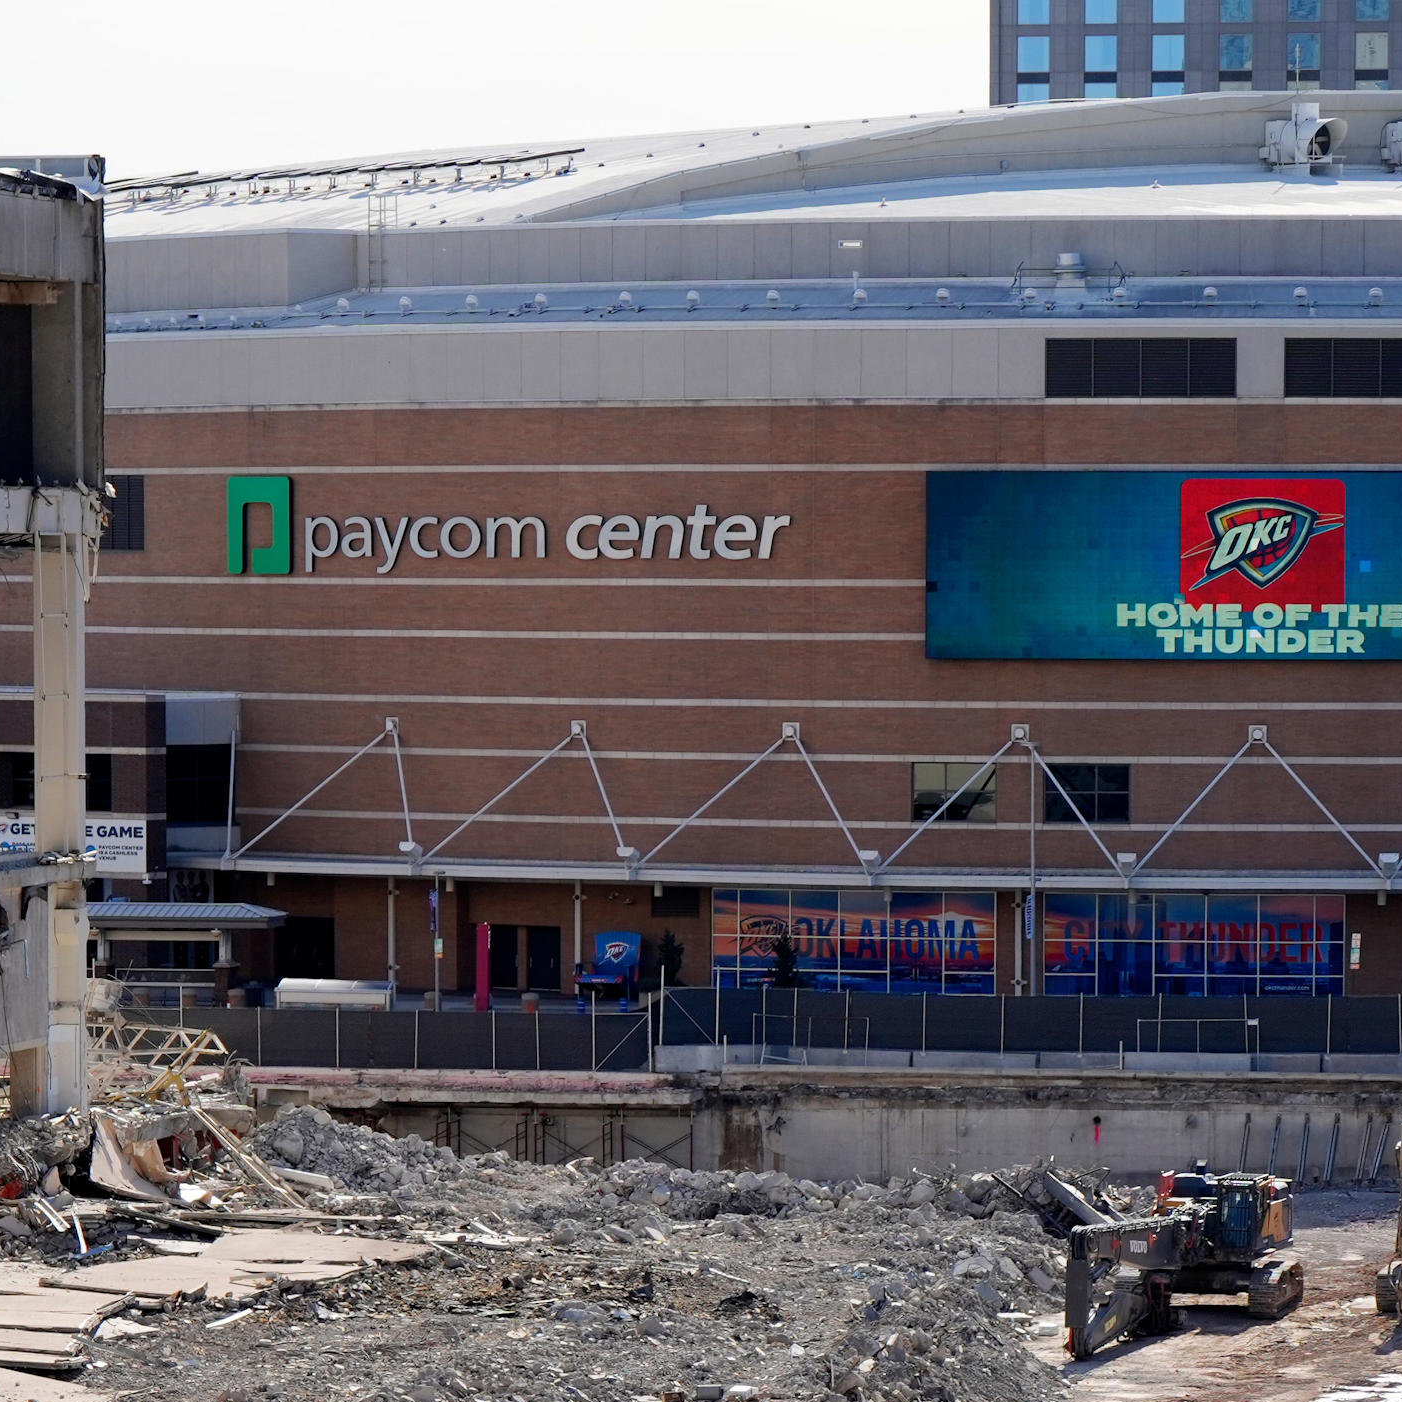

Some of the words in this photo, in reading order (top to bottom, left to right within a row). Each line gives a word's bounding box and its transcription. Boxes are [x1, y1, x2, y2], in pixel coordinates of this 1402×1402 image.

[305, 515, 547, 573] paycom
[565, 504, 791, 560] center
[1210, 513, 1294, 572] OKC
[1116, 602, 1243, 628] HOME
[1252, 602, 1314, 628] OF
[1156, 628, 1366, 654] THUNDER
[97, 825, 144, 838] GAME
[795, 916, 980, 960] OKLAHOMA
[1157, 921, 1324, 963] THUNDER
[1129, 1240, 1148, 1254] VOLVO
